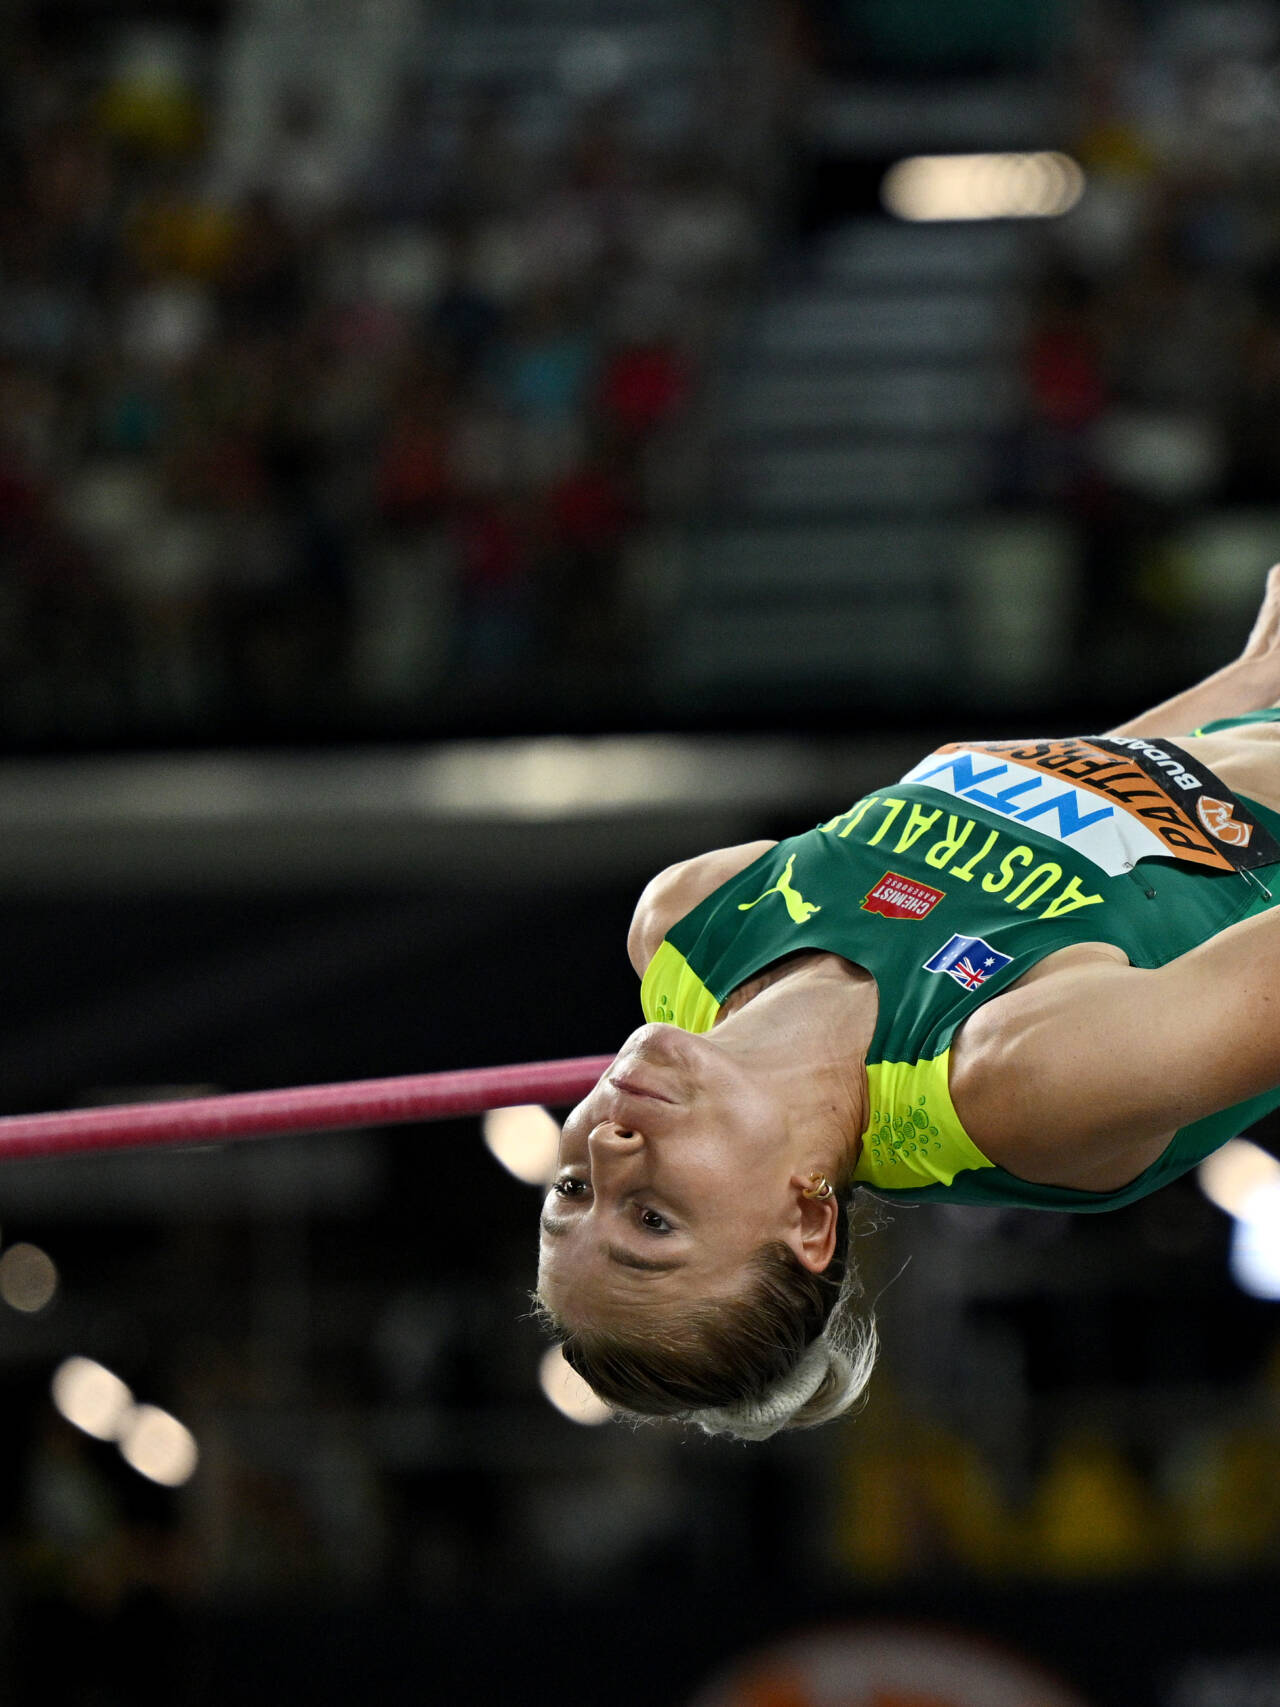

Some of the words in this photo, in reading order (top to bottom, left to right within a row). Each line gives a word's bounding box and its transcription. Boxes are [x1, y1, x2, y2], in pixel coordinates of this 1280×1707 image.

[1107, 737, 1202, 791] BUDAP
[912, 754, 1114, 839] NTN
[872, 885, 930, 915] CHEMIST
[885, 878, 937, 903] WAREHOUSE
